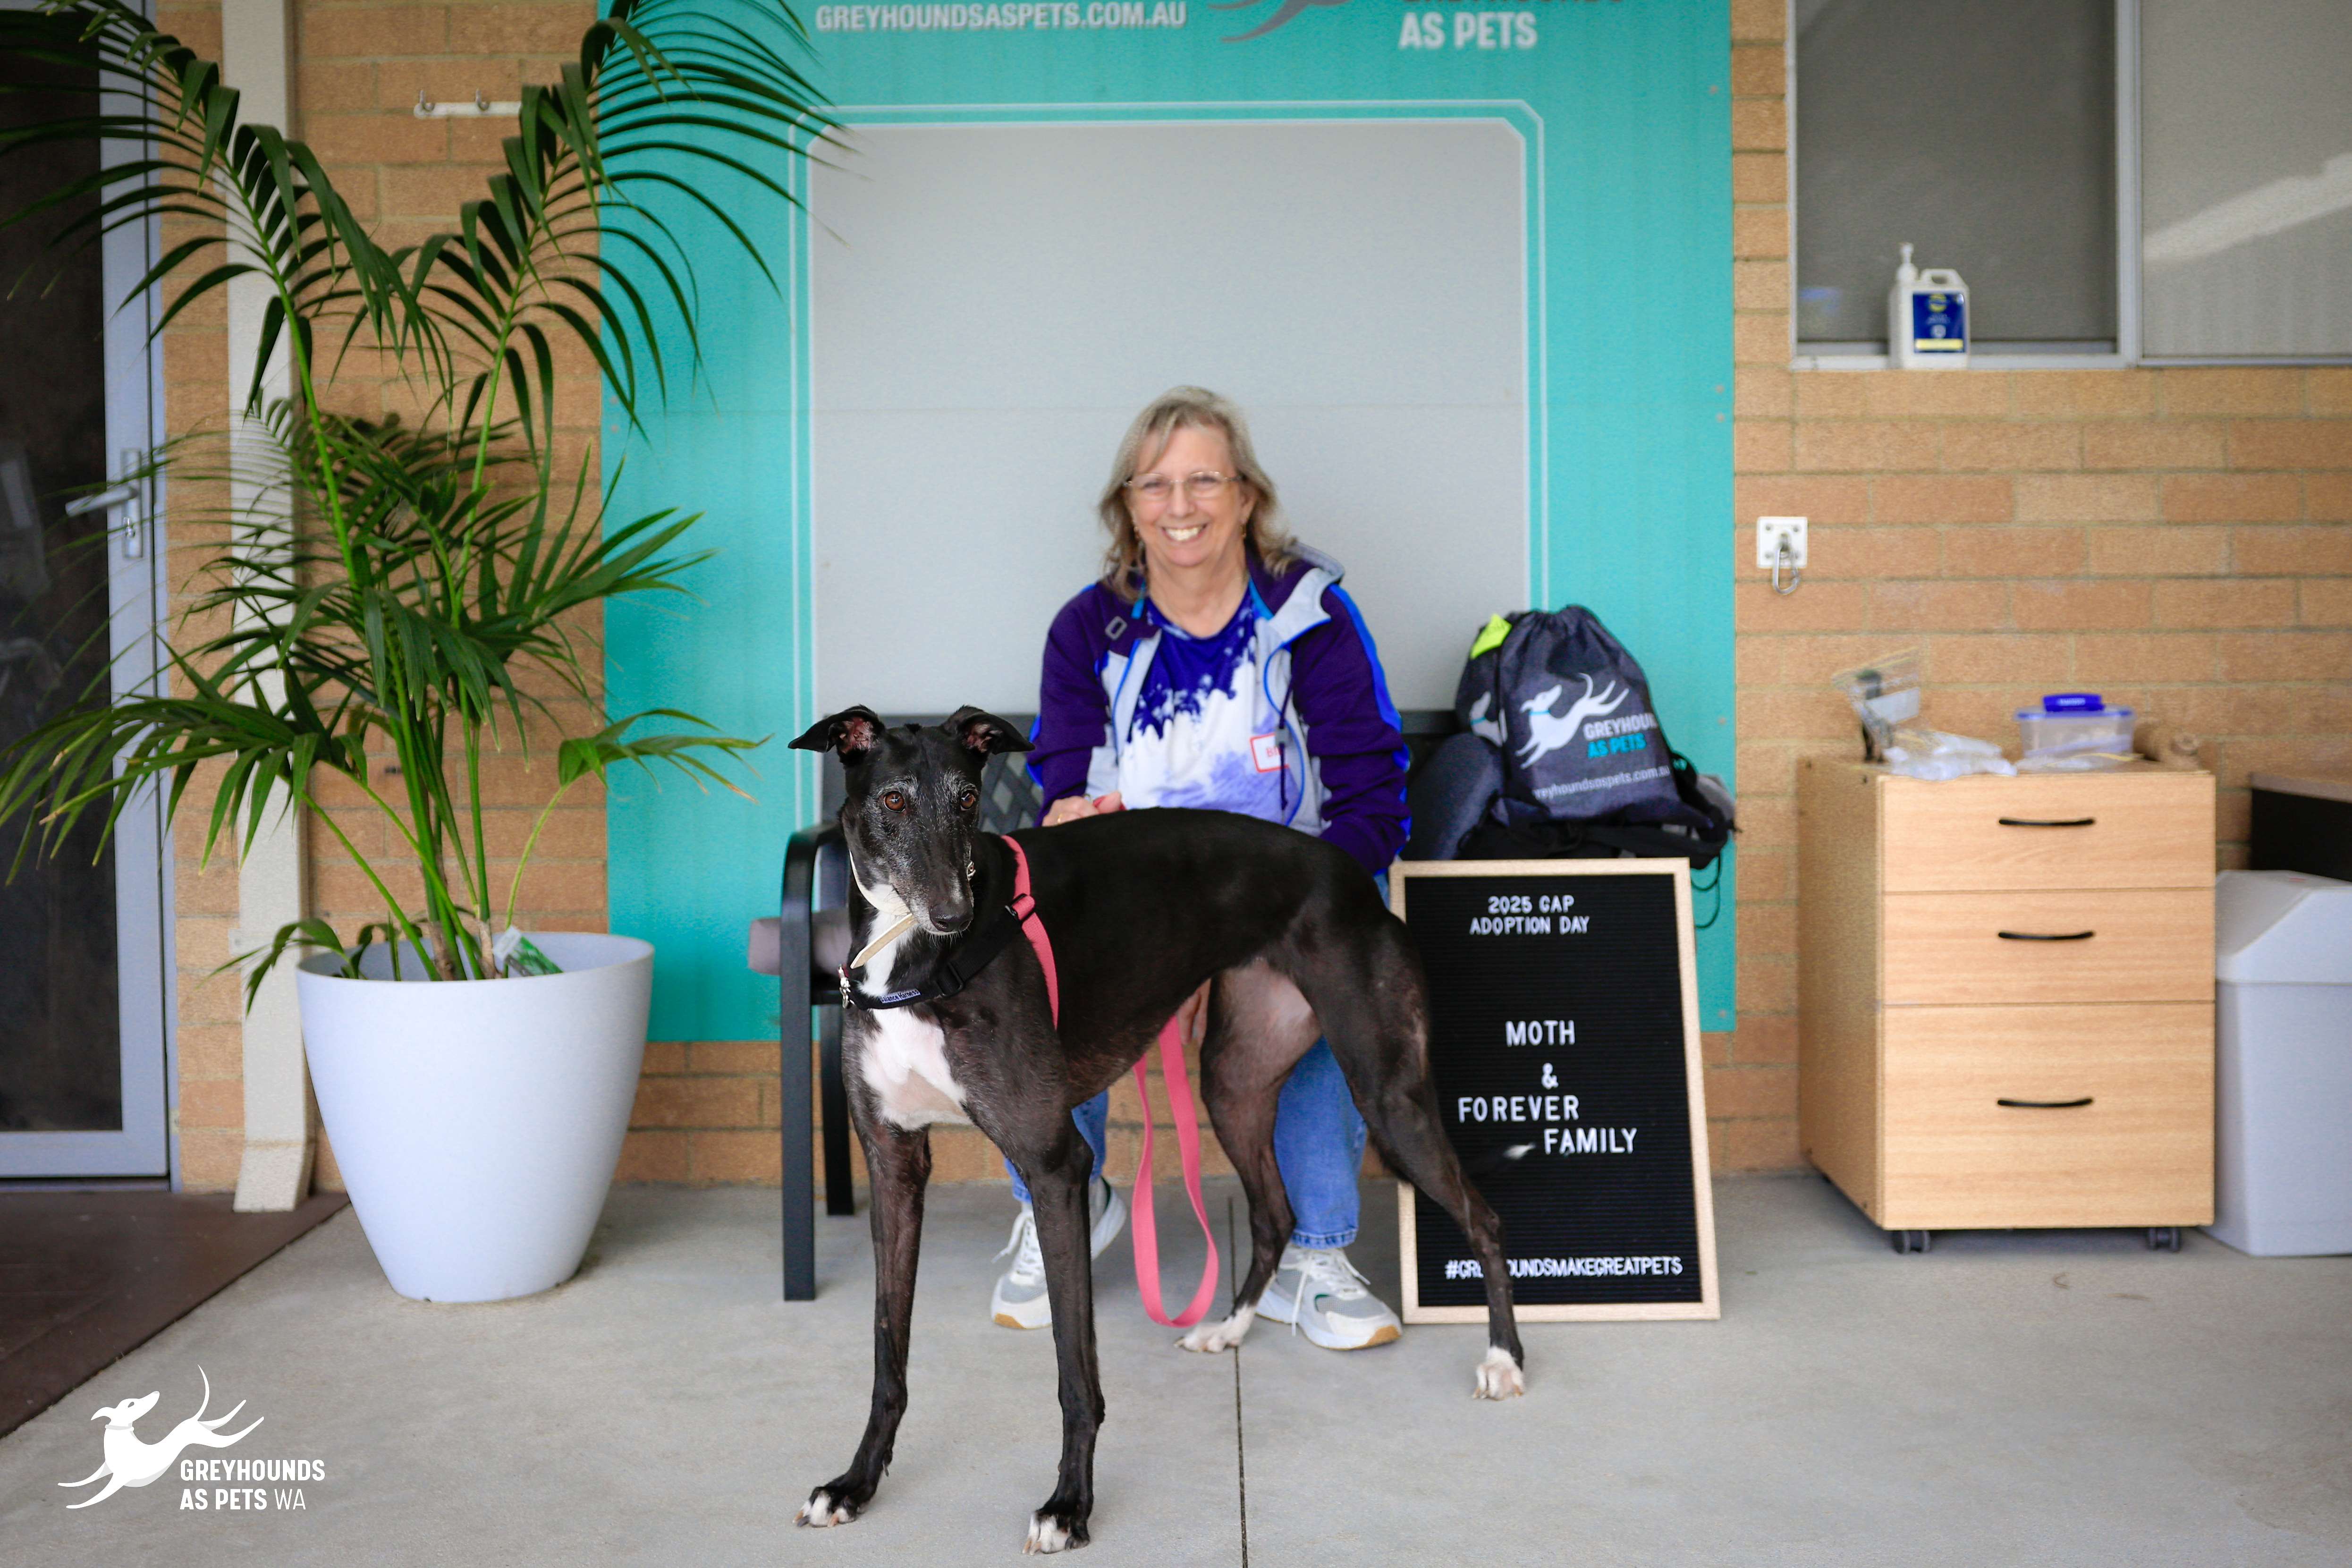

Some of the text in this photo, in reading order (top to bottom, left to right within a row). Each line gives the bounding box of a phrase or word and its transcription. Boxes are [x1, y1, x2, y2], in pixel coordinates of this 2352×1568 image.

[816, 2, 1186, 31] GREYHOUNDSASPETS.COM.AU
[1398, 11, 1538, 49] AS PETS
[1588, 733, 1646, 758] AS PETS
[1533, 765, 1670, 799] reyhoundsaspets.com.au
[1488, 895, 1574, 915] 2025 GAP
[1470, 915, 1590, 935] ADOPTION DAY
[897, 990, 919, 999] Harness
[1505, 1020, 1575, 1046] MOTH
[1541, 1062, 1559, 1089] &
[1458, 1095, 1579, 1122] FOREVER
[1544, 1127, 1637, 1154] FAMILY
[1445, 1256, 1683, 1280] #GROUNDSMAKEGREATPETS
